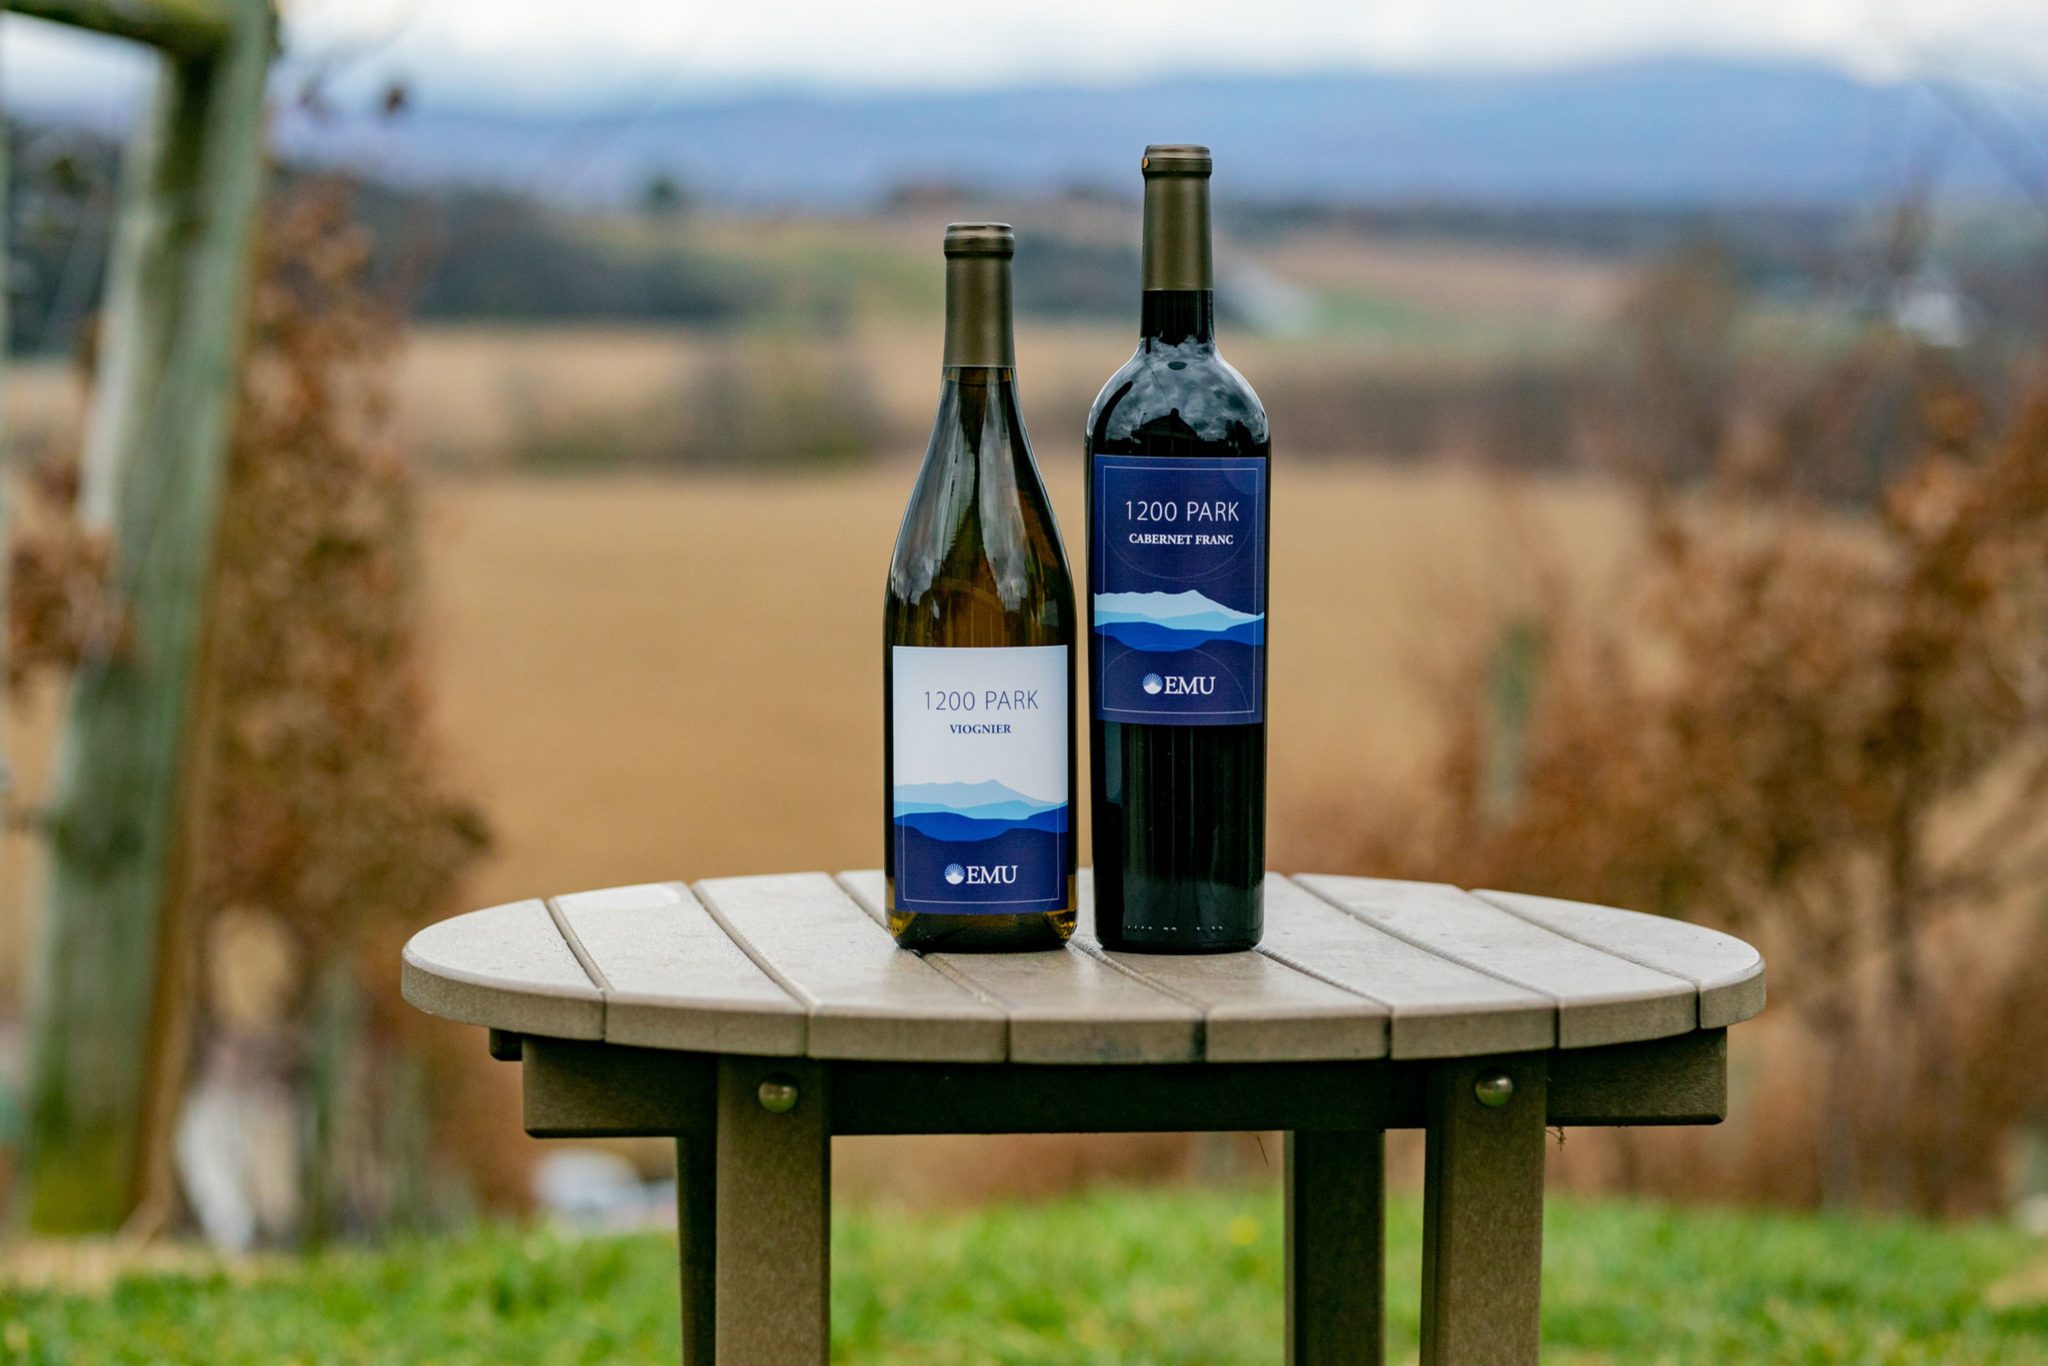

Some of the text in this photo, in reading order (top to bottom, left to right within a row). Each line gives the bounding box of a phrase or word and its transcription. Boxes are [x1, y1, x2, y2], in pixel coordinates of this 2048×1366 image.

[1125, 501, 1239, 522] 1200 PARK
[1129, 533, 1234, 545] CABERNET FRANC
[1164, 676, 1216, 695] EMU
[924, 689, 1039, 711] 1200 PARK
[950, 724, 1011, 734] VIOGNIER
[966, 865, 1018, 884] EMU
